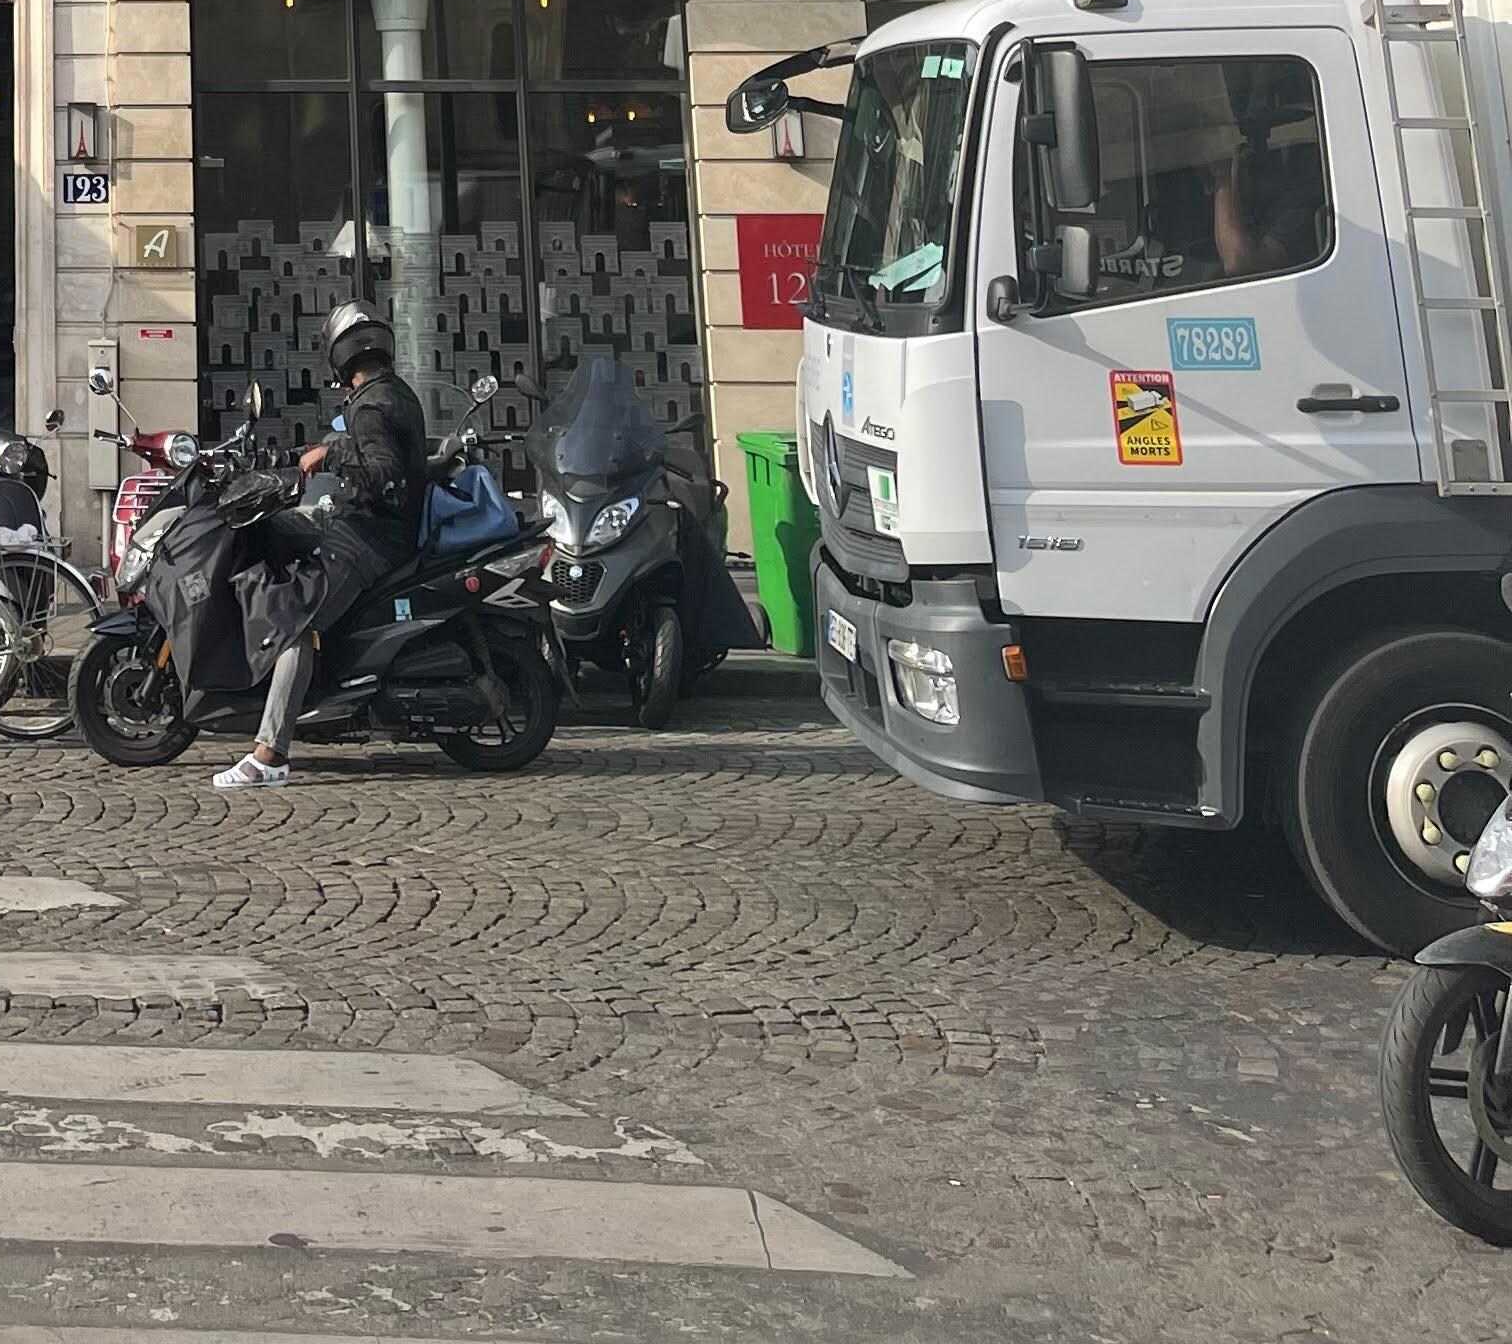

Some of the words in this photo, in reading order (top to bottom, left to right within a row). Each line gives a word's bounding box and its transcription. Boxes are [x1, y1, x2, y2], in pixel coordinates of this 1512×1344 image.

[66, 176, 107, 202] 123
[143, 229, 169, 258] A
[1176, 327, 1251, 361] 78282
[1113, 373, 1170, 383] ATTENTION
[1127, 436, 1171, 446] ANGLES
[1130, 446, 1171, 456] MORTS
